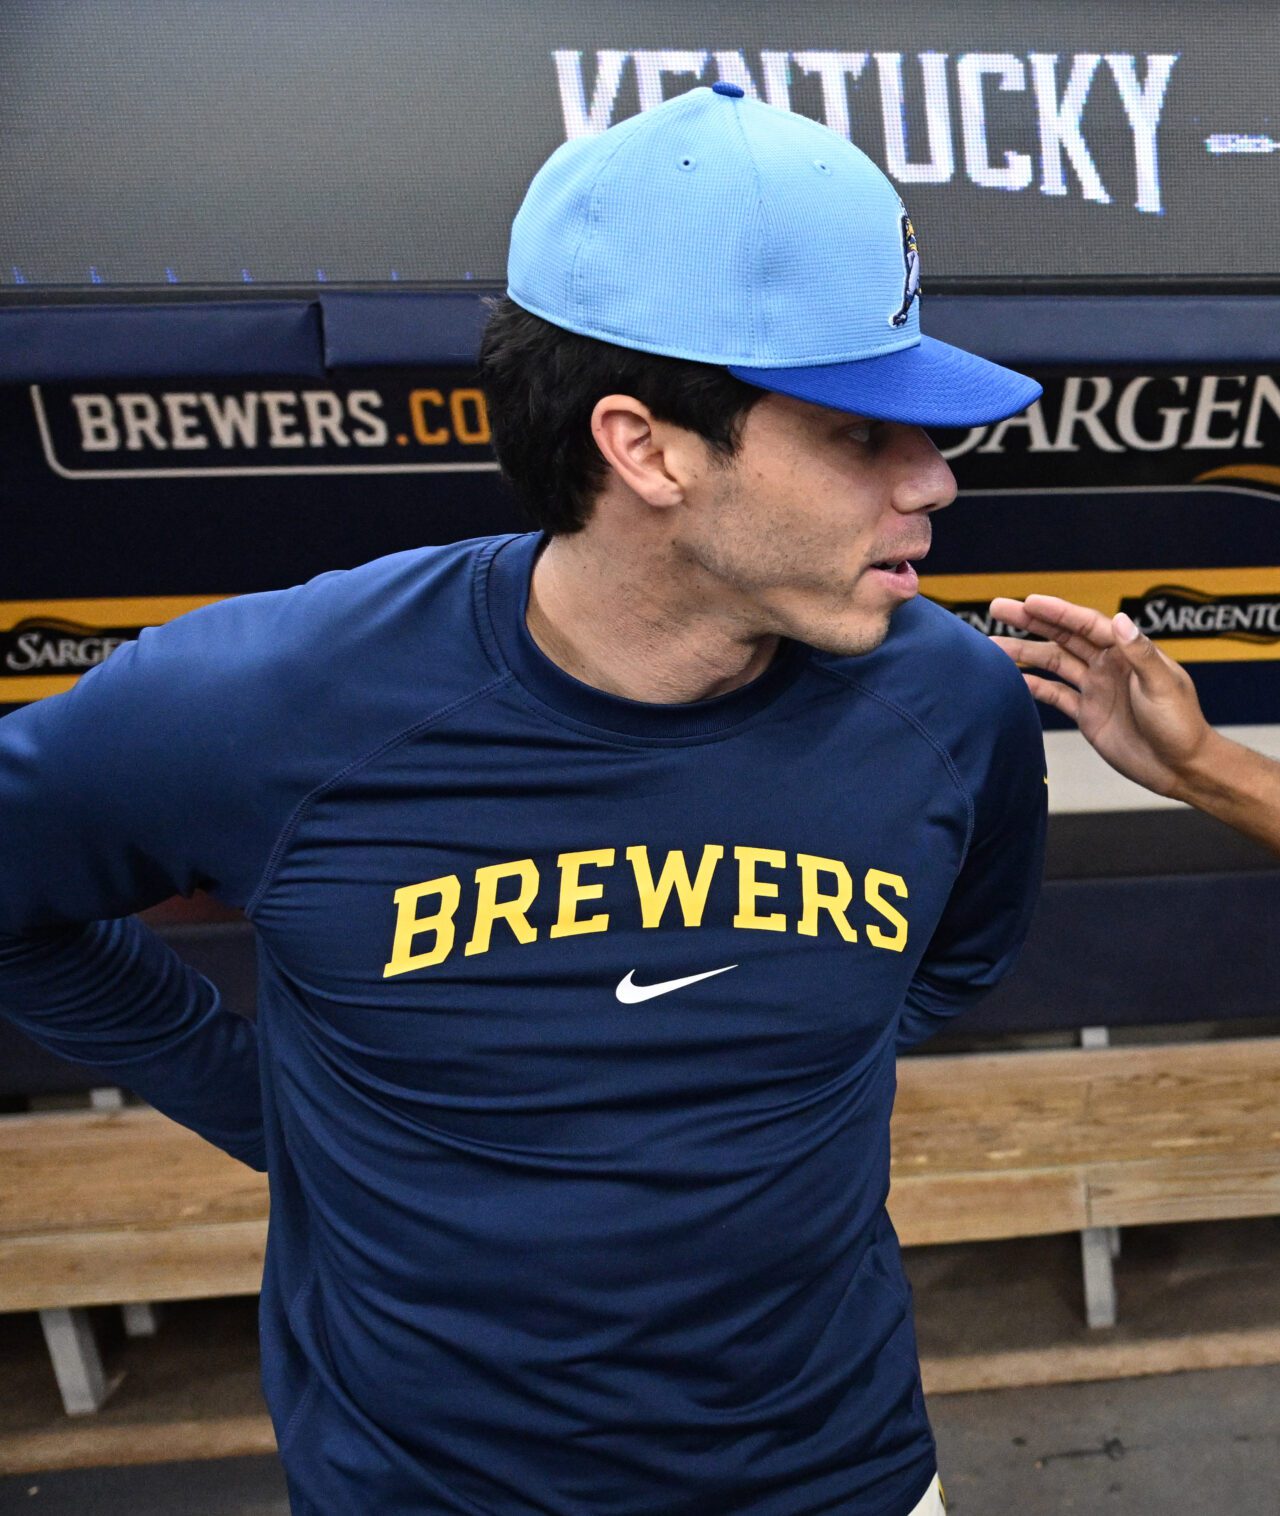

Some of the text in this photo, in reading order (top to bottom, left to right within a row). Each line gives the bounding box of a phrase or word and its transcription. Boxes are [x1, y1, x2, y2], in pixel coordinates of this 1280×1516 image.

[71, 388, 492, 452] BREWERS.CO
[6, 632, 127, 671] SARG
[383, 844, 909, 978] BREWERS
